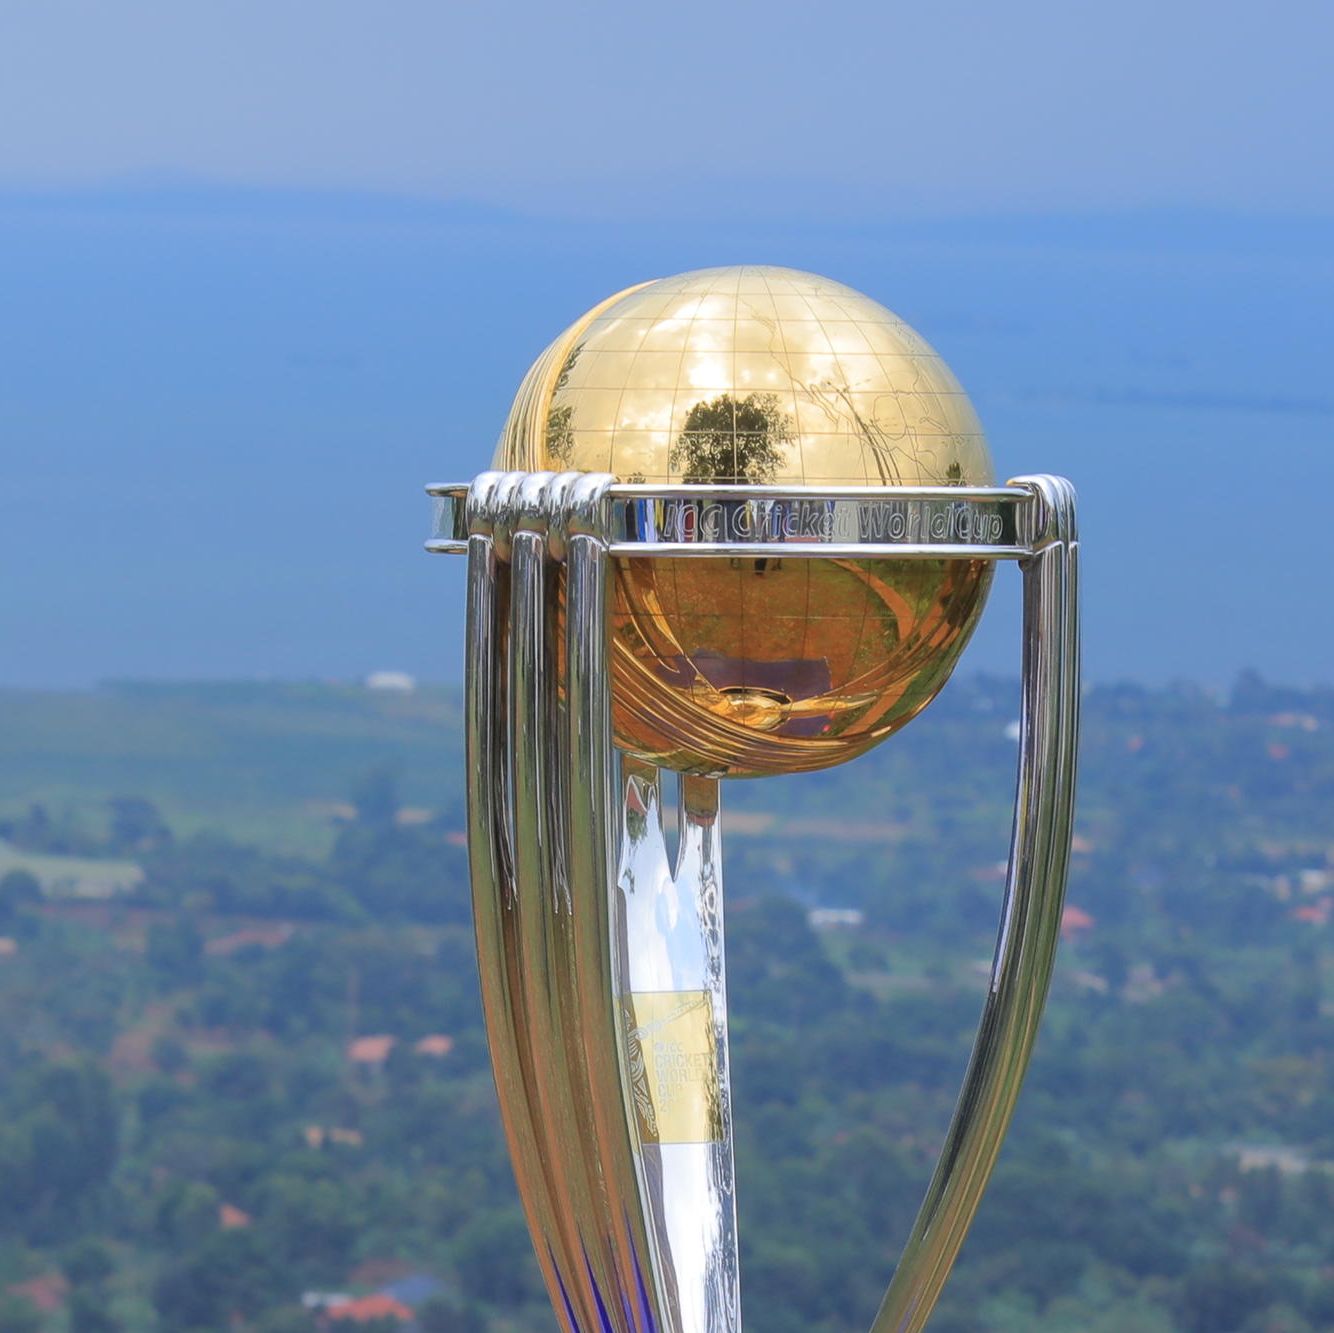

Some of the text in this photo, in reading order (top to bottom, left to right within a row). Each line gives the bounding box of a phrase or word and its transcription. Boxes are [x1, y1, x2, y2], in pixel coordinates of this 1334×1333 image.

[664, 503, 1004, 543] ICC Cricket World Cup
